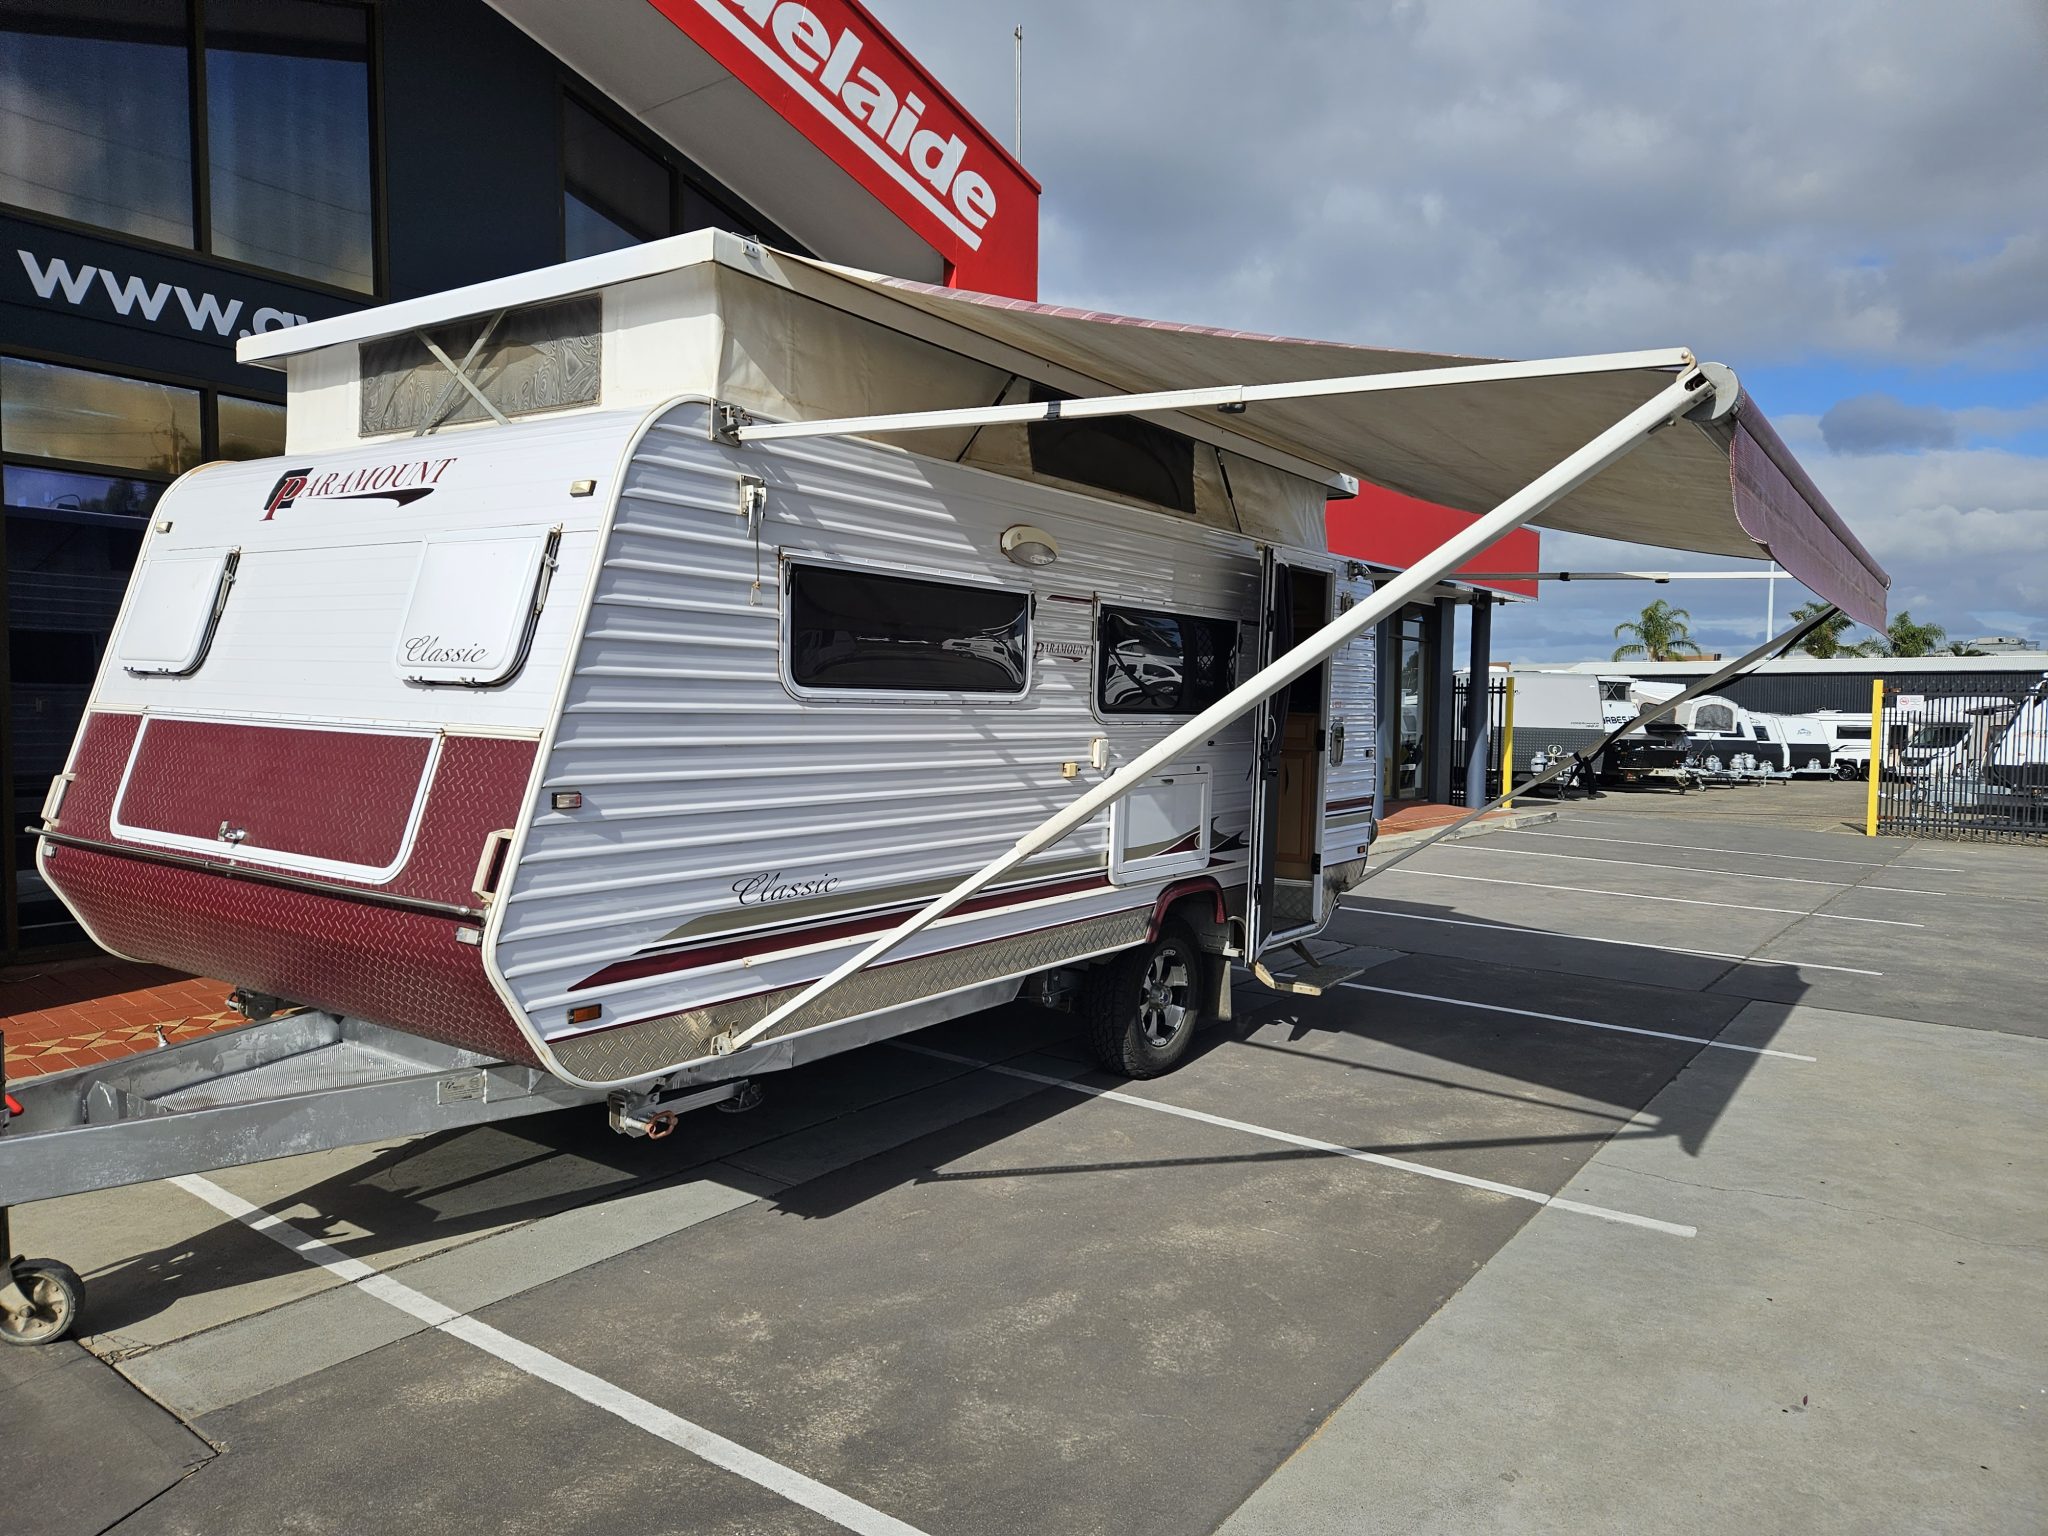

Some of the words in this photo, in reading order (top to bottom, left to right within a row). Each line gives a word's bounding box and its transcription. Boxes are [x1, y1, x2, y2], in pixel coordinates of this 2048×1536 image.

[17, 249, 309, 338] www.a
[259, 457, 459, 521] PARAMOUNT
[405, 635, 489, 662] Classic
[1033, 642, 1090, 659] PARAMOUNT
[732, 872, 840, 905] Classic
